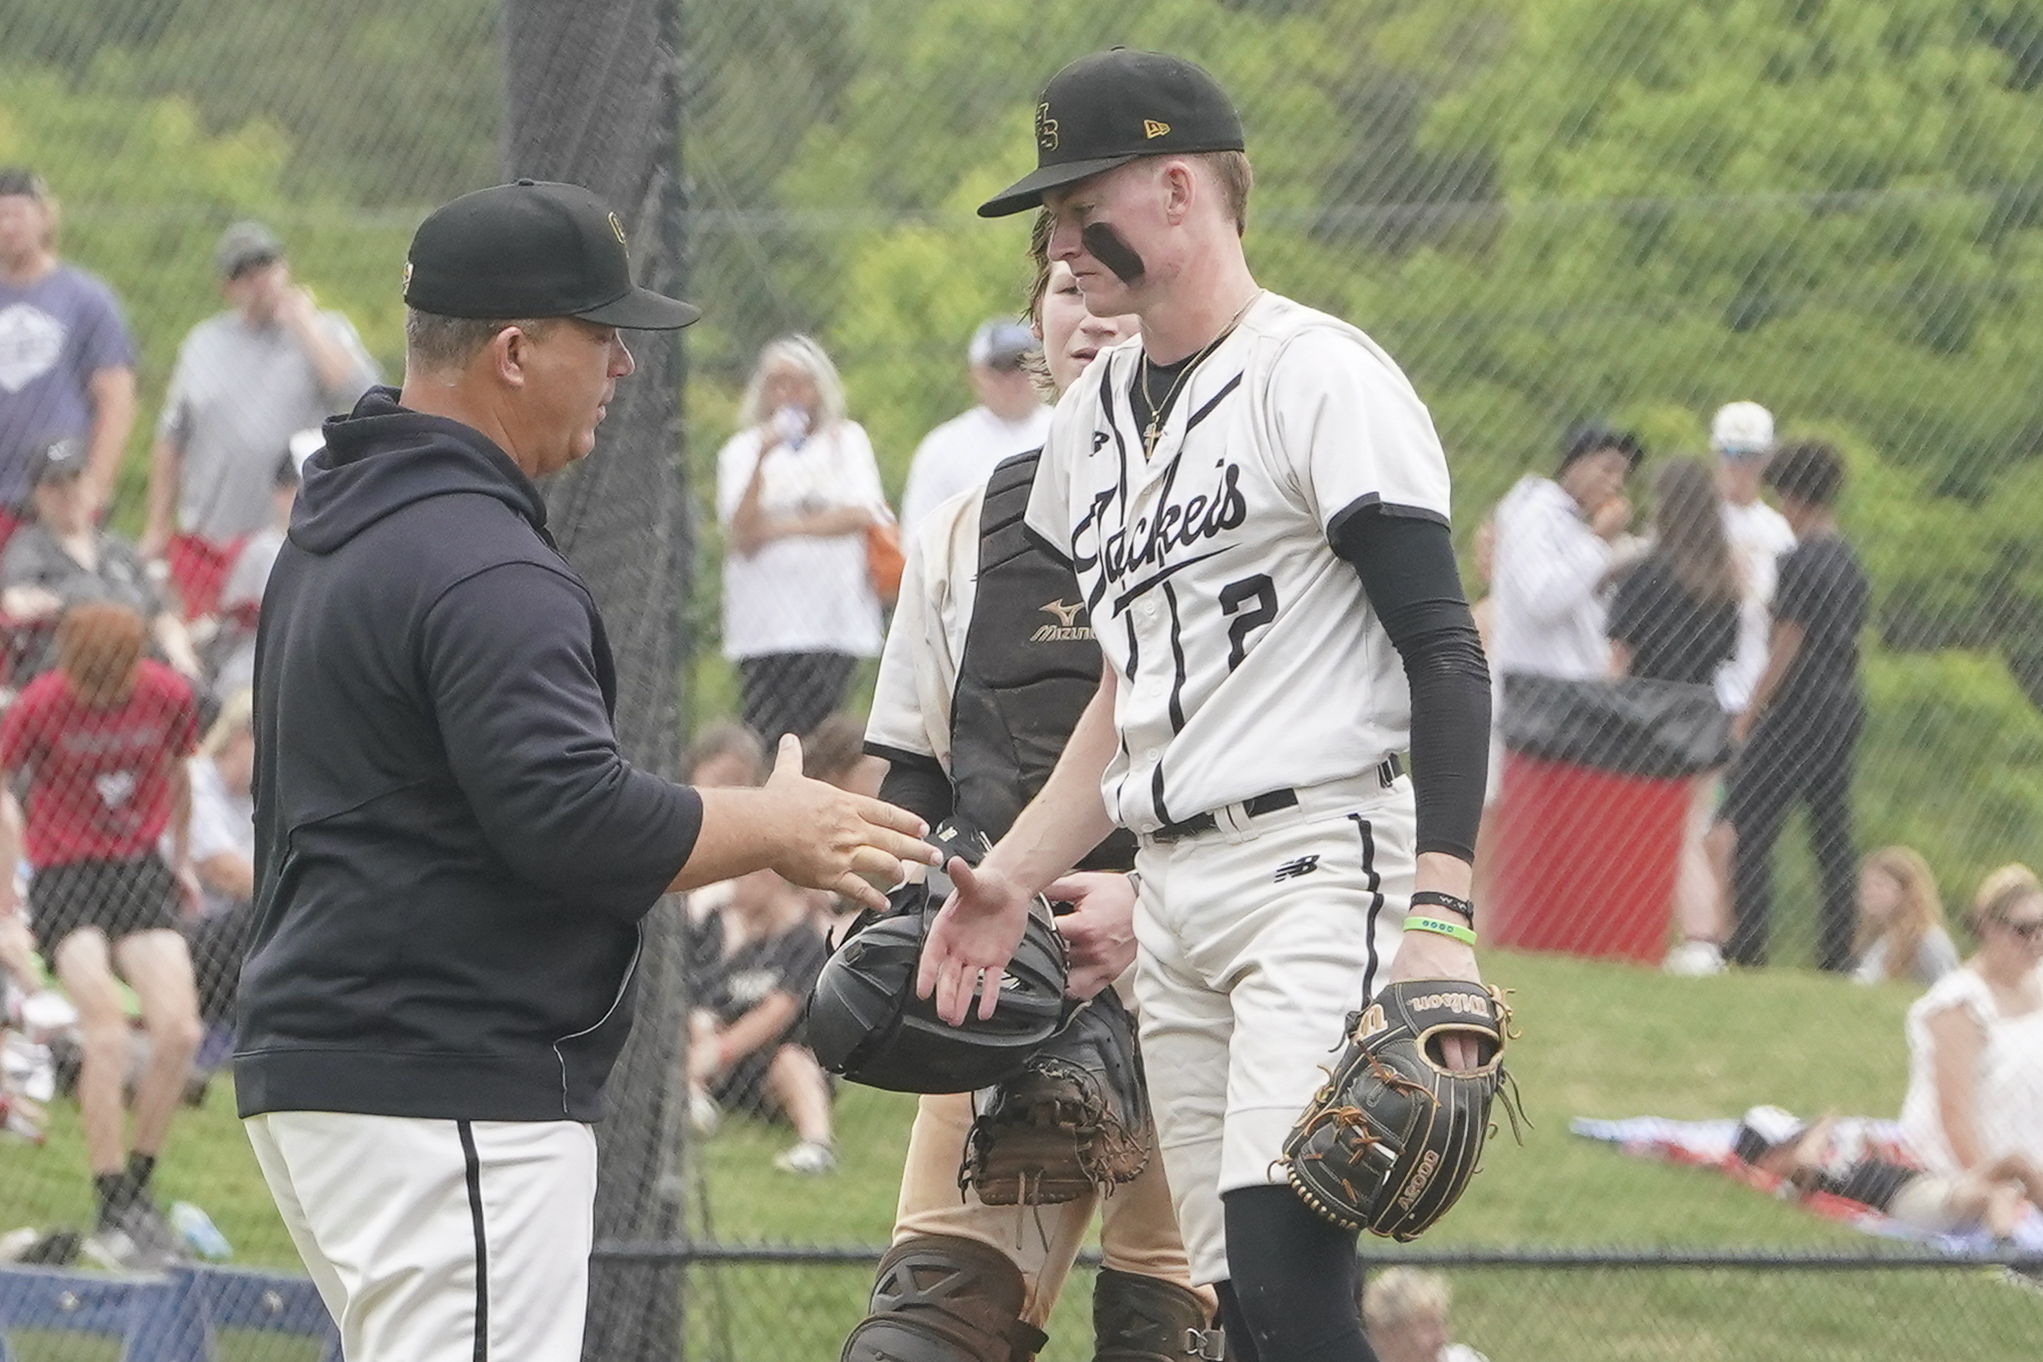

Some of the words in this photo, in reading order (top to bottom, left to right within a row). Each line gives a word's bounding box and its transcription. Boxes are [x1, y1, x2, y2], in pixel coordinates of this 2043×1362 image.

[1218, 572, 1279, 673] 2
[1407, 992, 1490, 1019] Wilson
[1398, 1149, 1440, 1211] A2000
